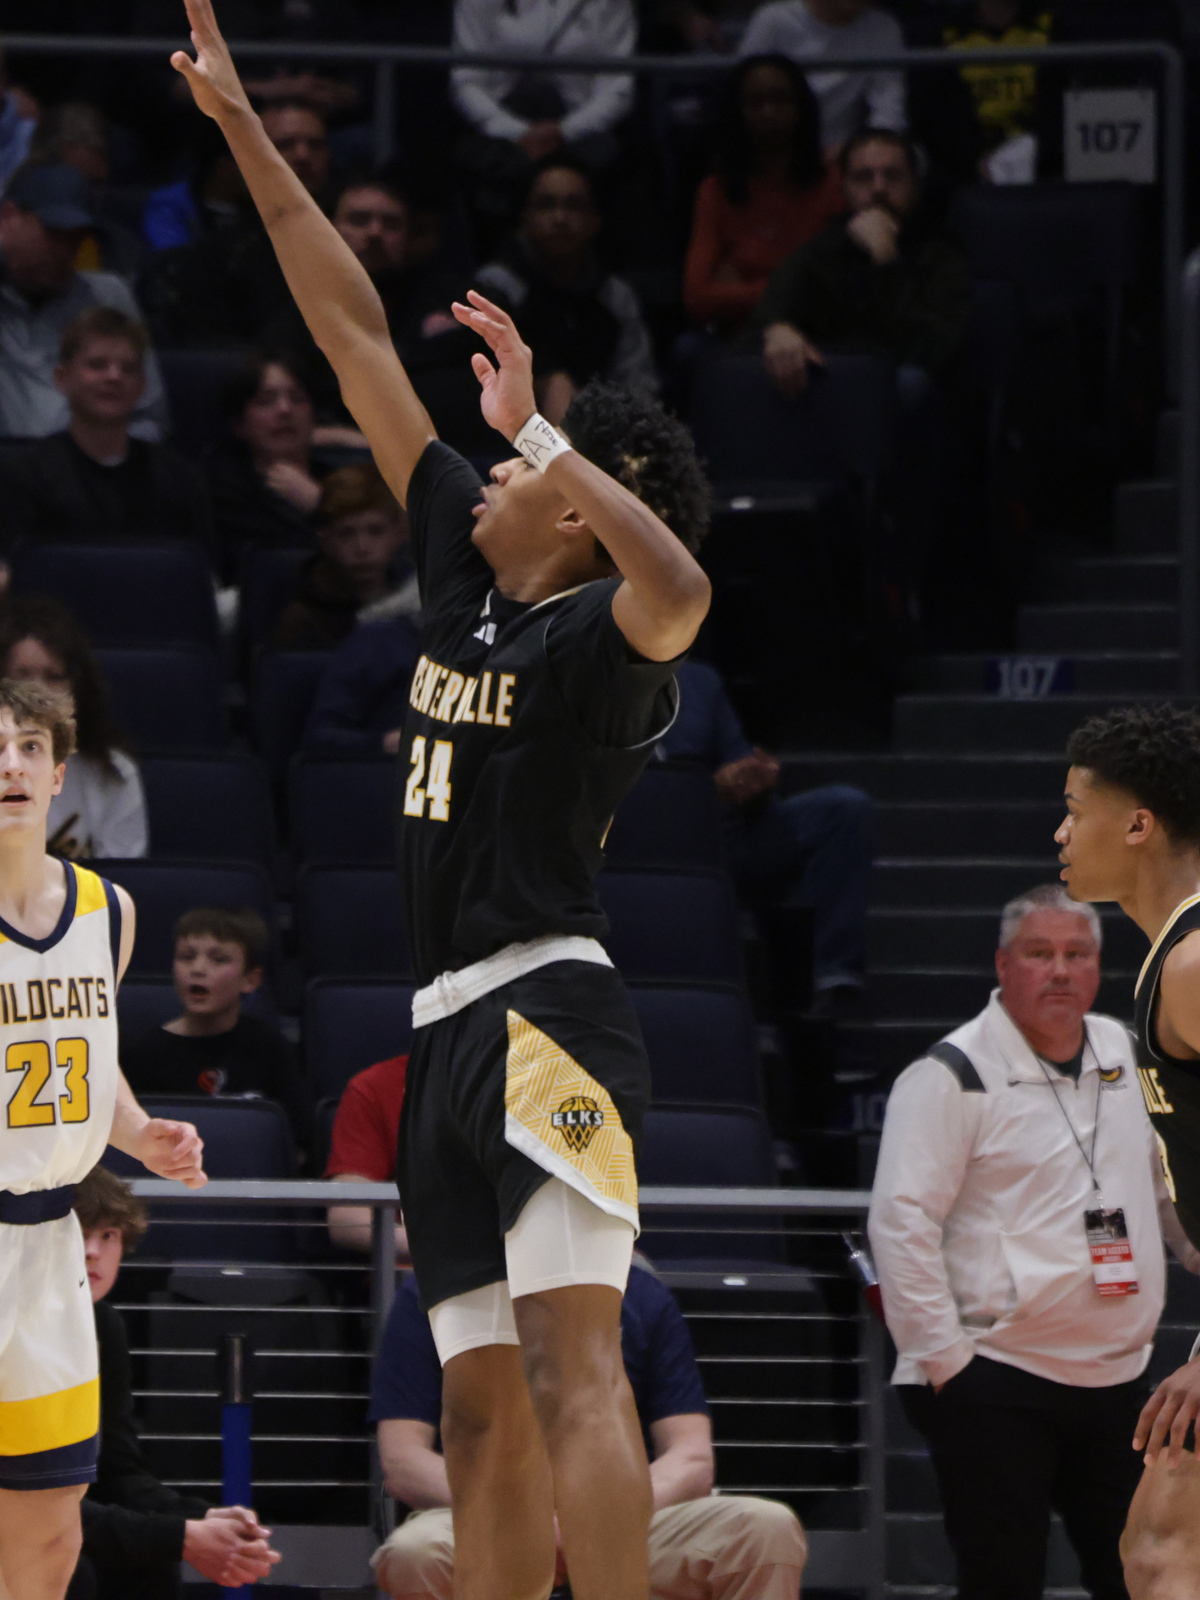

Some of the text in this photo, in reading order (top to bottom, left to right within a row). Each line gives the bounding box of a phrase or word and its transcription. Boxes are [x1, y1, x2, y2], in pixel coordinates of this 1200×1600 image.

[1078, 122, 1142, 153] 107
[1000, 661, 1056, 699] 107
[403, 735, 453, 822] 24
[5, 1036, 90, 1129] 23
[552, 1110, 603, 1127] ELKS
